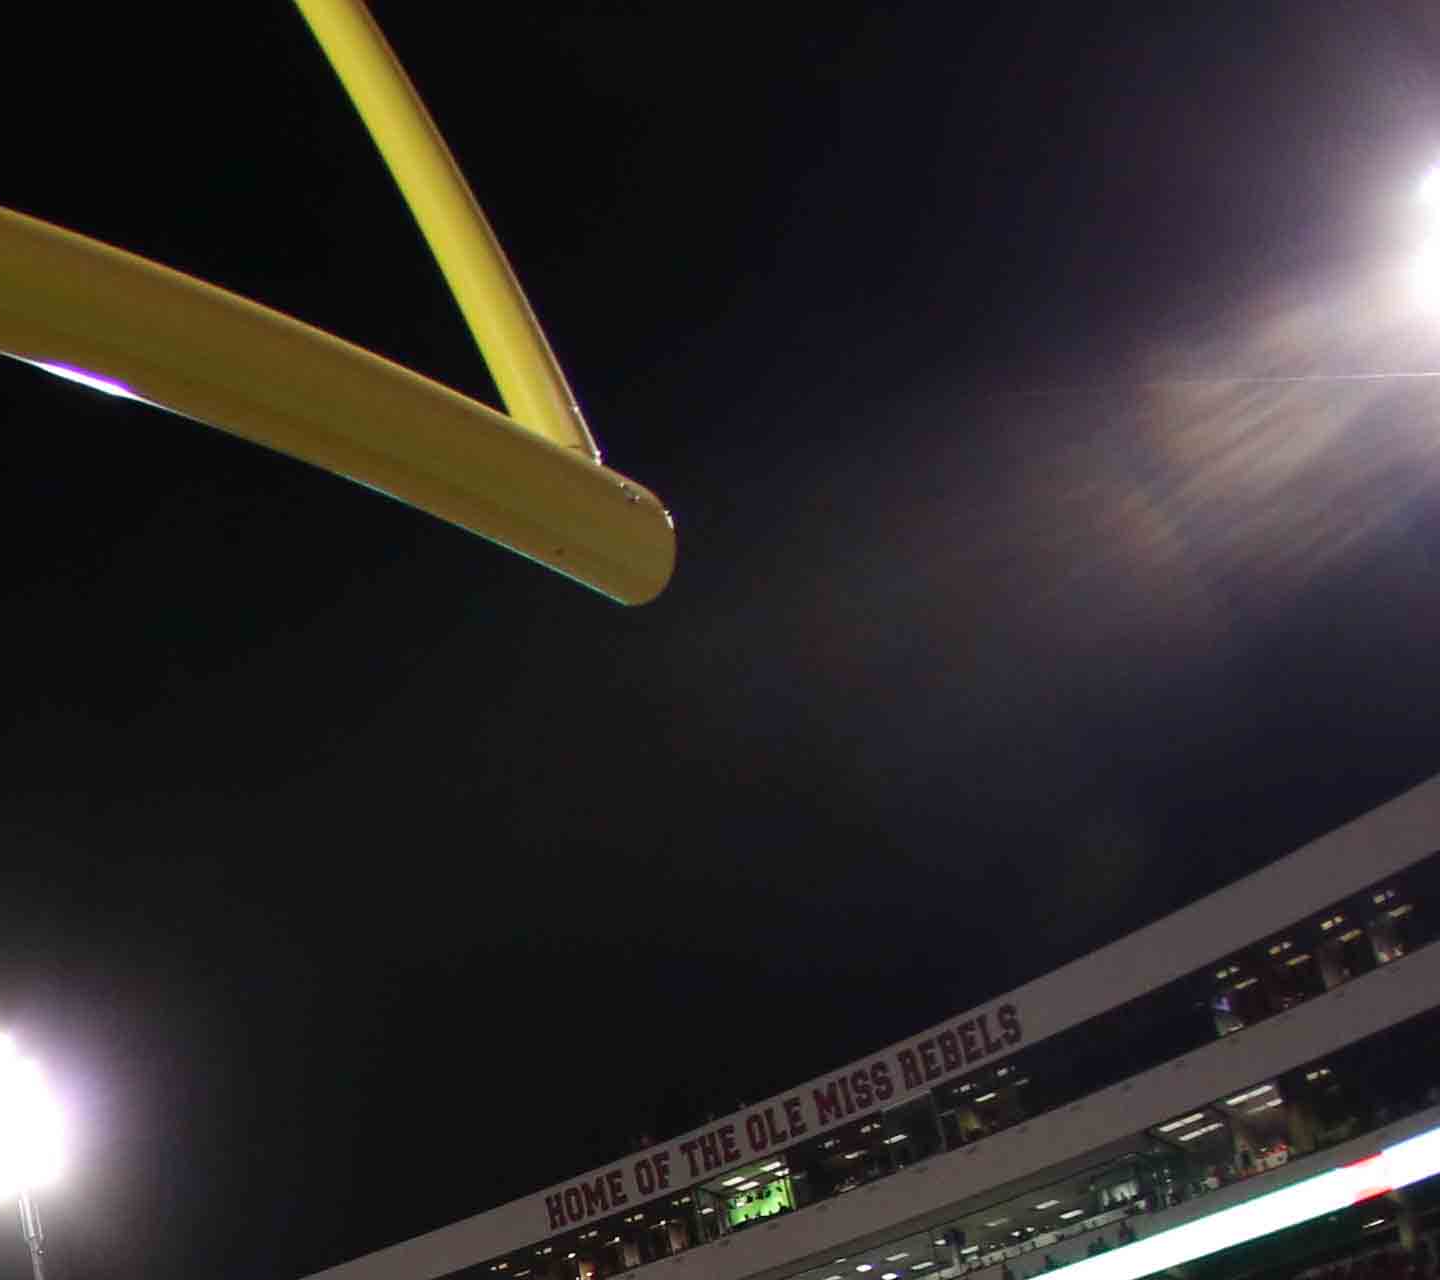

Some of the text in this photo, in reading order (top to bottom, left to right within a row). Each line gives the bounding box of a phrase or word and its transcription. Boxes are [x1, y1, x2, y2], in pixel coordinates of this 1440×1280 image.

[544, 1003, 1023, 1230] HOME OF THE OLE MISS REBELS
